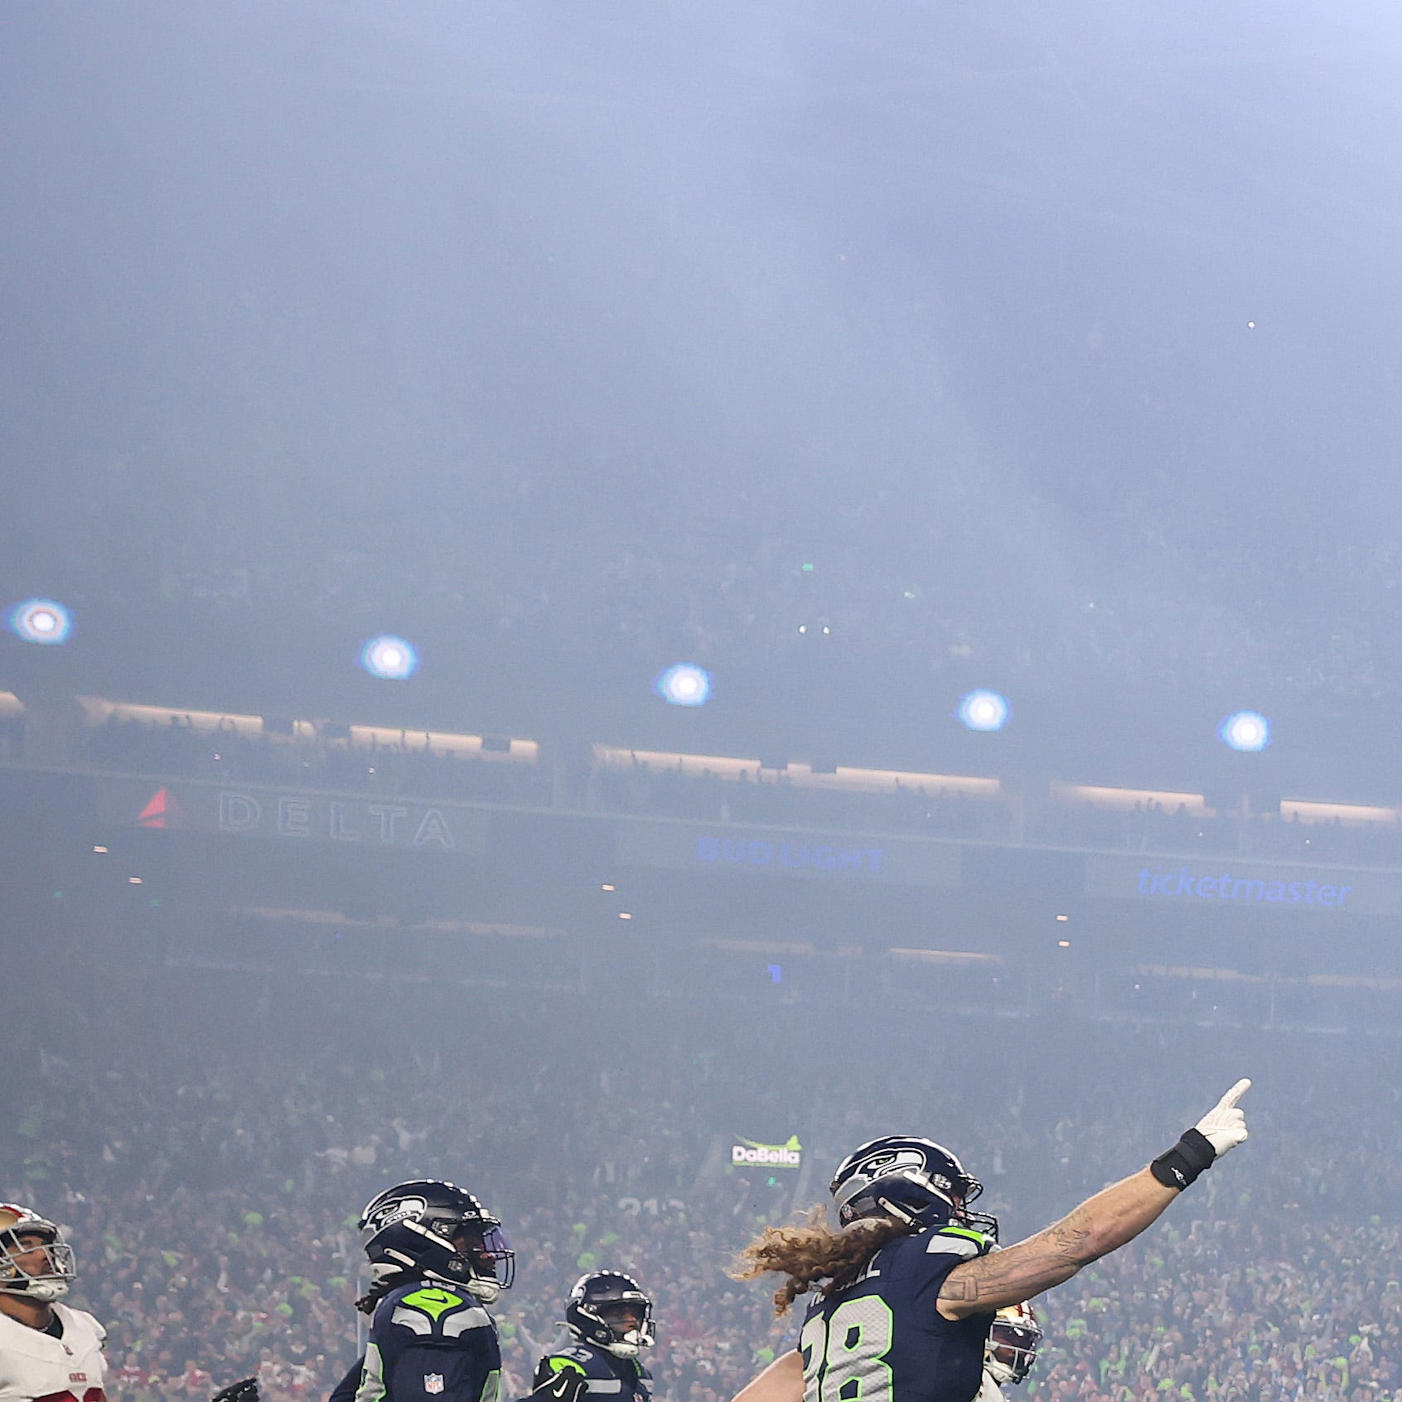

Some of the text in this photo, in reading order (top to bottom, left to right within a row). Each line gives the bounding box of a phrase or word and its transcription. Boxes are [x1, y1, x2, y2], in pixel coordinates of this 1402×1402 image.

[219, 792, 455, 849] DELTA
[696, 836, 887, 872] BUD LIGHT
[1136, 866, 1352, 906] ticketmaster
[732, 1146, 800, 1163] DaBella
